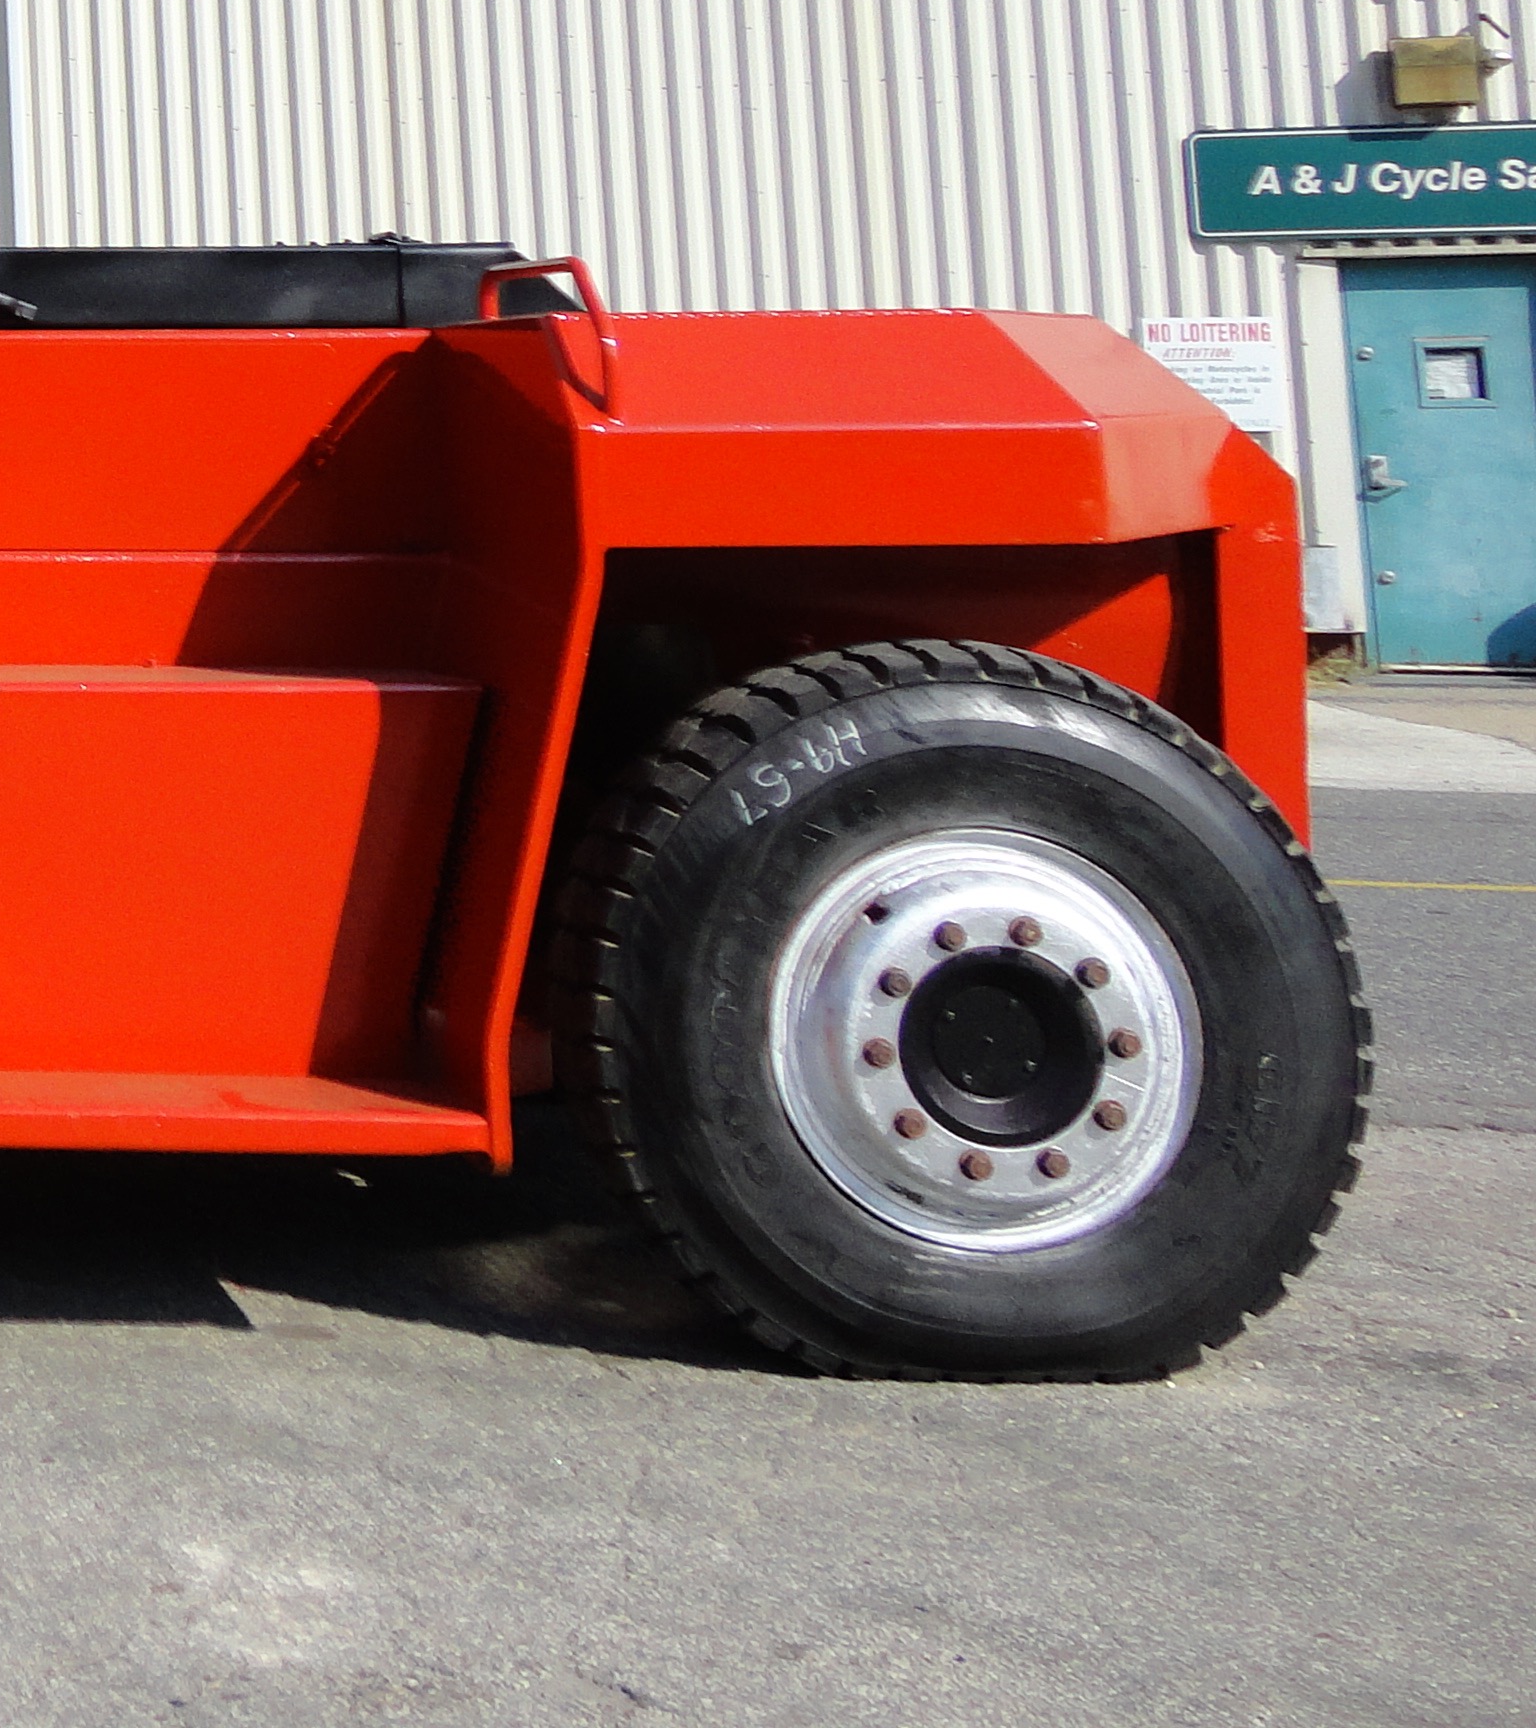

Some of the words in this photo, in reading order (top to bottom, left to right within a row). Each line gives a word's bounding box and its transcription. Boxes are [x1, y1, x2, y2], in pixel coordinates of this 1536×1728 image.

[1248, 165, 1281, 195] A
[1291, 164, 1322, 194] &
[1331, 163, 1358, 193] J
[1368, 161, 1488, 200] Cycle
[1147, 323, 1171, 343] NO
[1180, 322, 1272, 343] LOITERING
